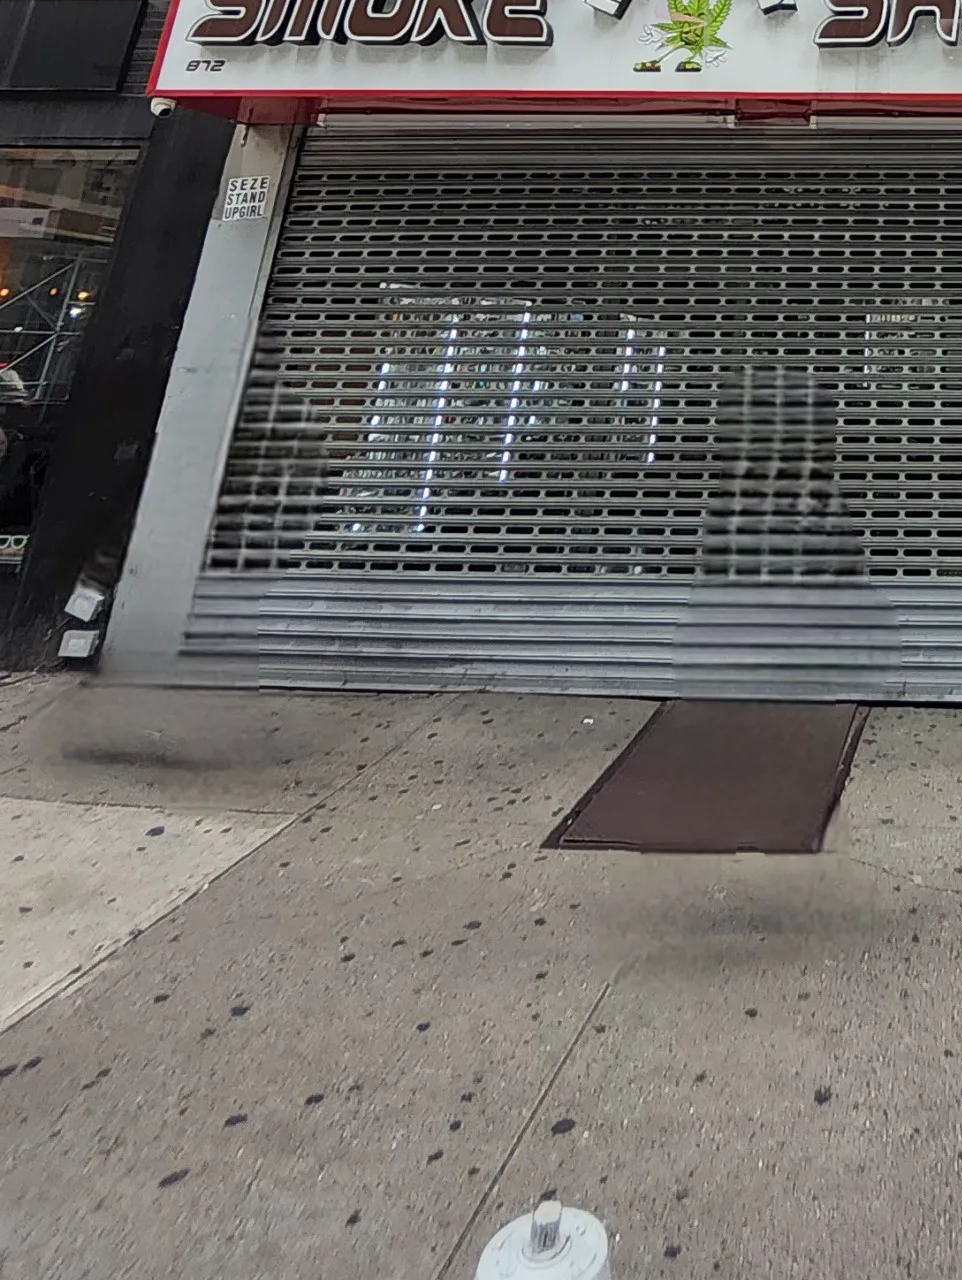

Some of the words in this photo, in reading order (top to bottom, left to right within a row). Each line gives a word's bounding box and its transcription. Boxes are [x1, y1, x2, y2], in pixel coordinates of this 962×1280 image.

[186, 59, 226, 73] 872
[229, 176, 269, 192] SEZE
[226, 190, 266, 206] STAND
